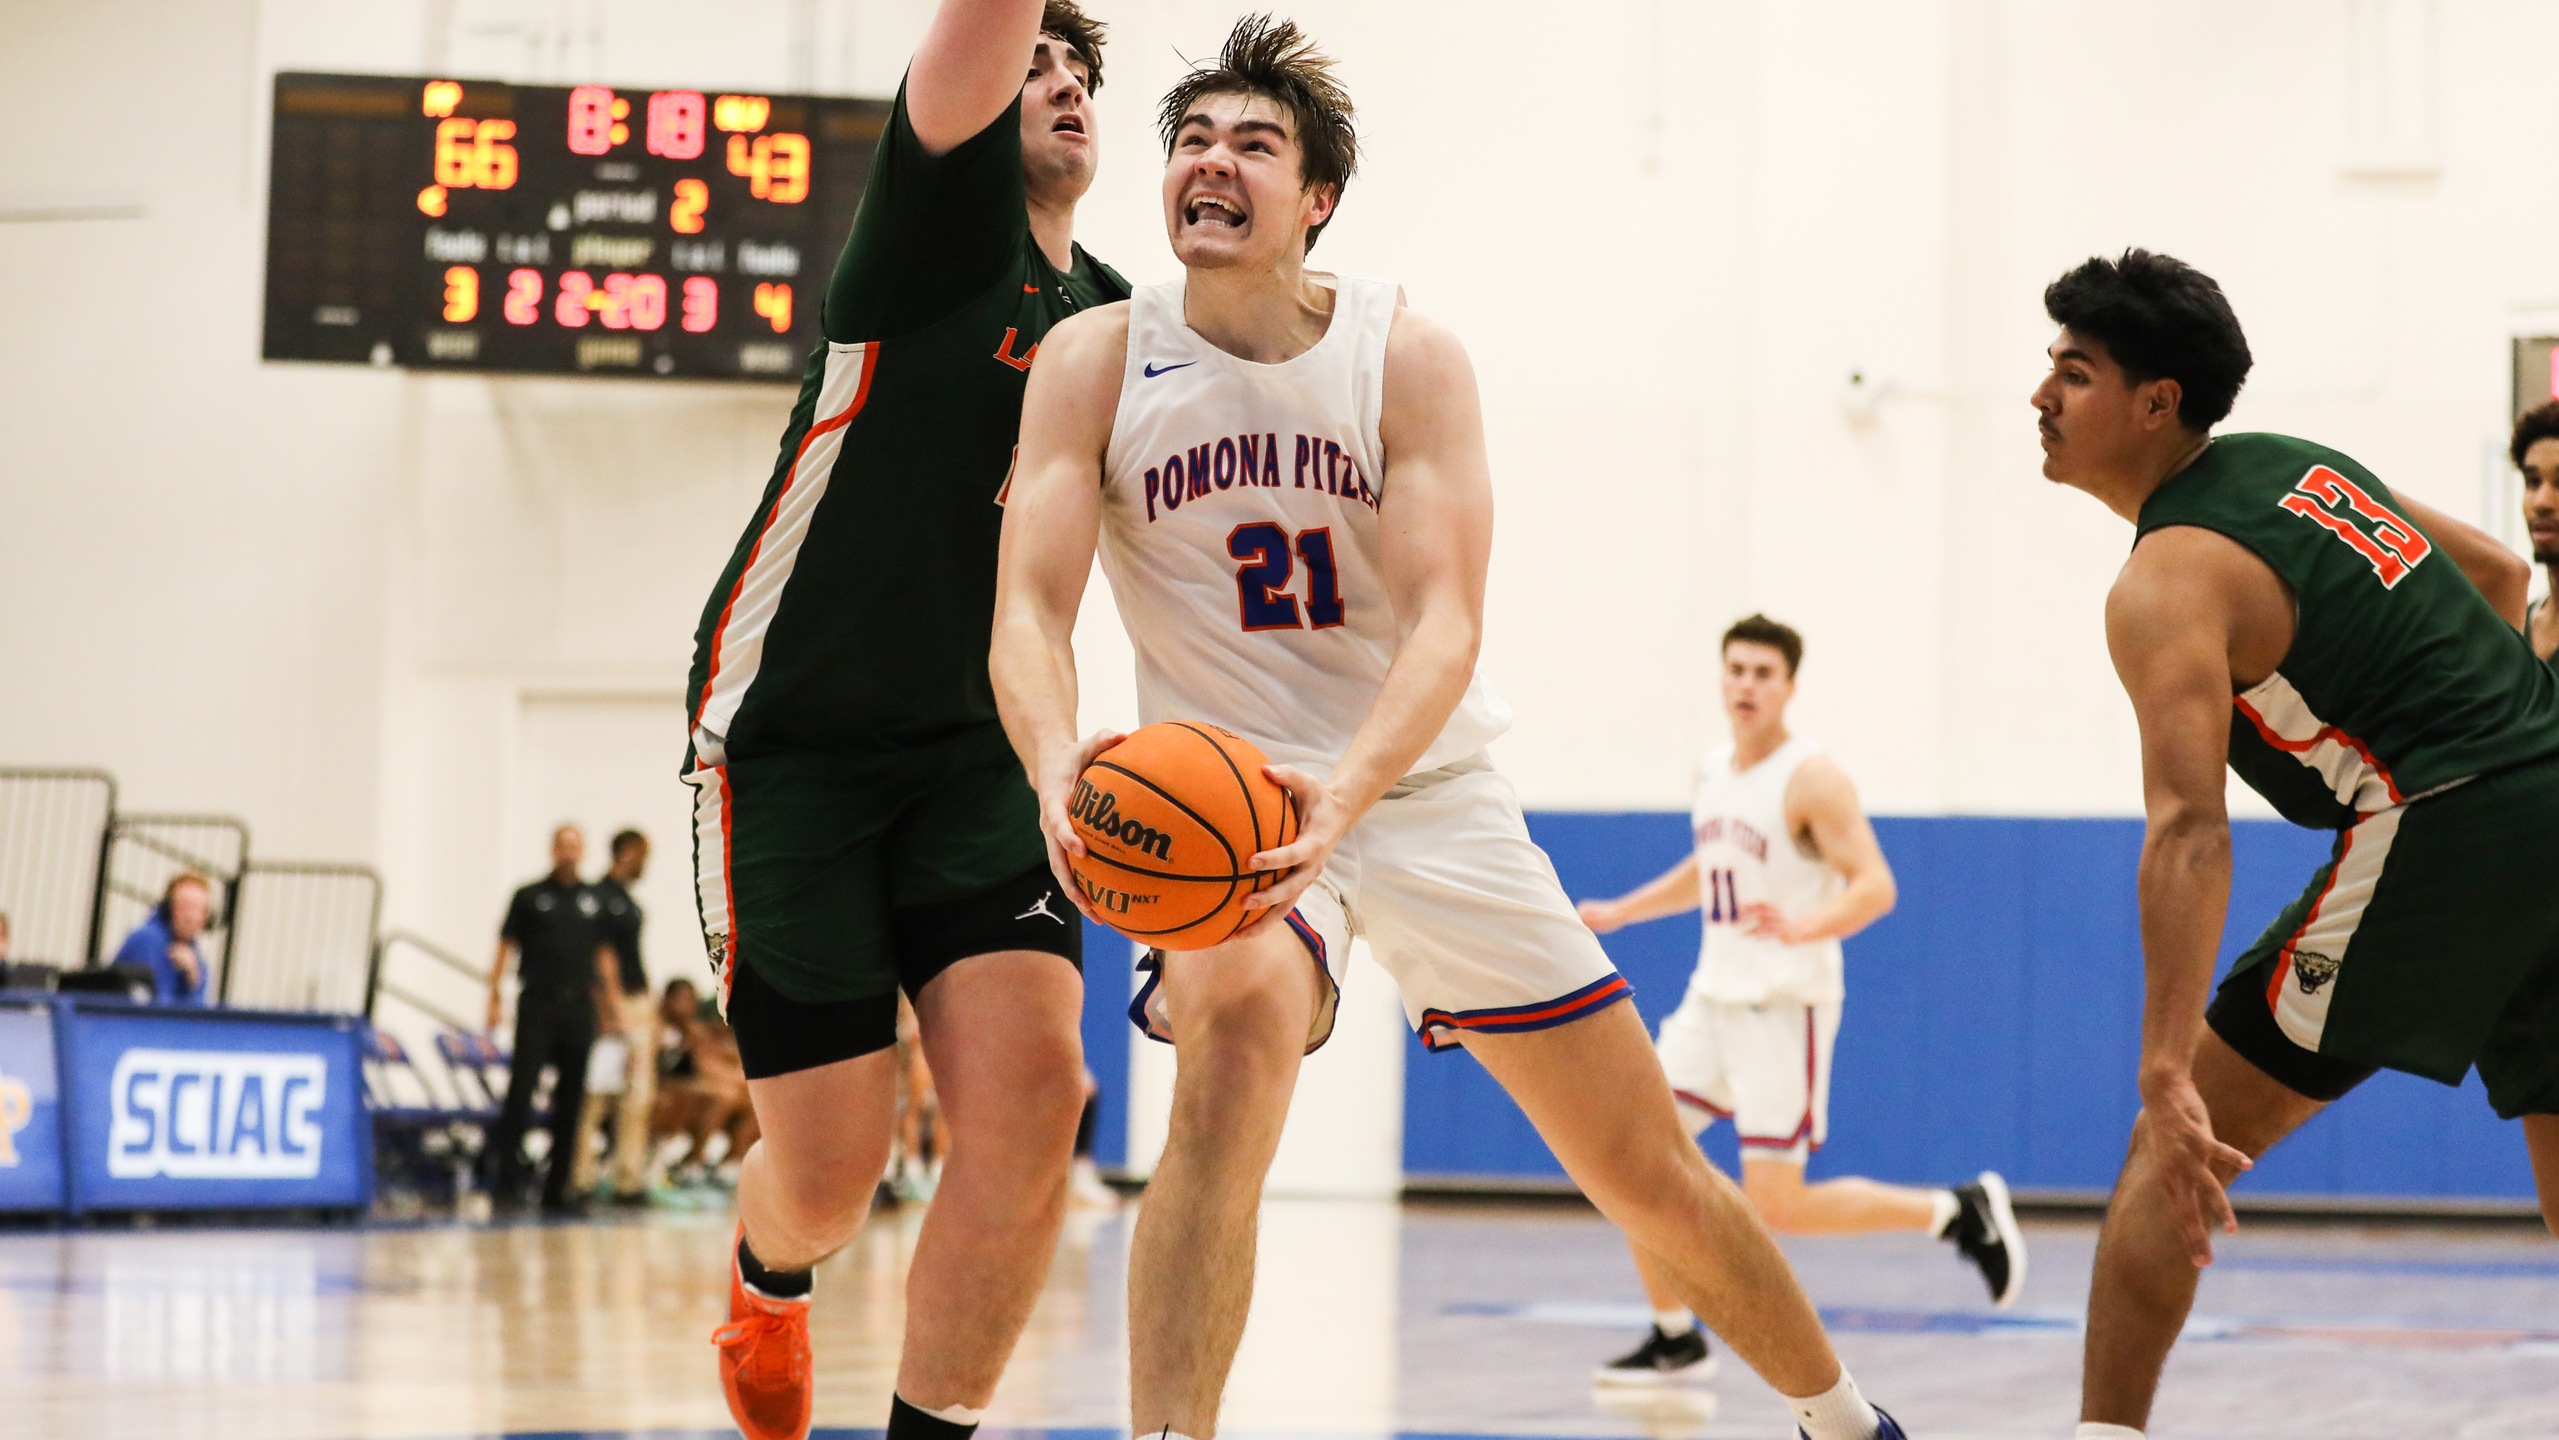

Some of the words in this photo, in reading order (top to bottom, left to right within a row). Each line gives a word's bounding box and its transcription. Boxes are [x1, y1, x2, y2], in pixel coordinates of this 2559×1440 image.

[434, 117, 519, 190] 66
[567, 84, 706, 160] 8:18
[726, 132, 811, 204] 43
[670, 178, 710, 234] 2
[443, 266, 480, 323] 3
[504, 268, 544, 325] 2
[681, 275, 718, 333] 3
[754, 282, 793, 333] 4
[1144, 433, 1281, 524] POMONA
[1294, 434, 1380, 515] PITZ
[2277, 464, 2432, 590] 13
[1226, 521, 1345, 632] 21
[1069, 778, 1172, 862] Wilson
[1710, 868, 1739, 923] 11
[119, 1065, 316, 1162] SCIAC
